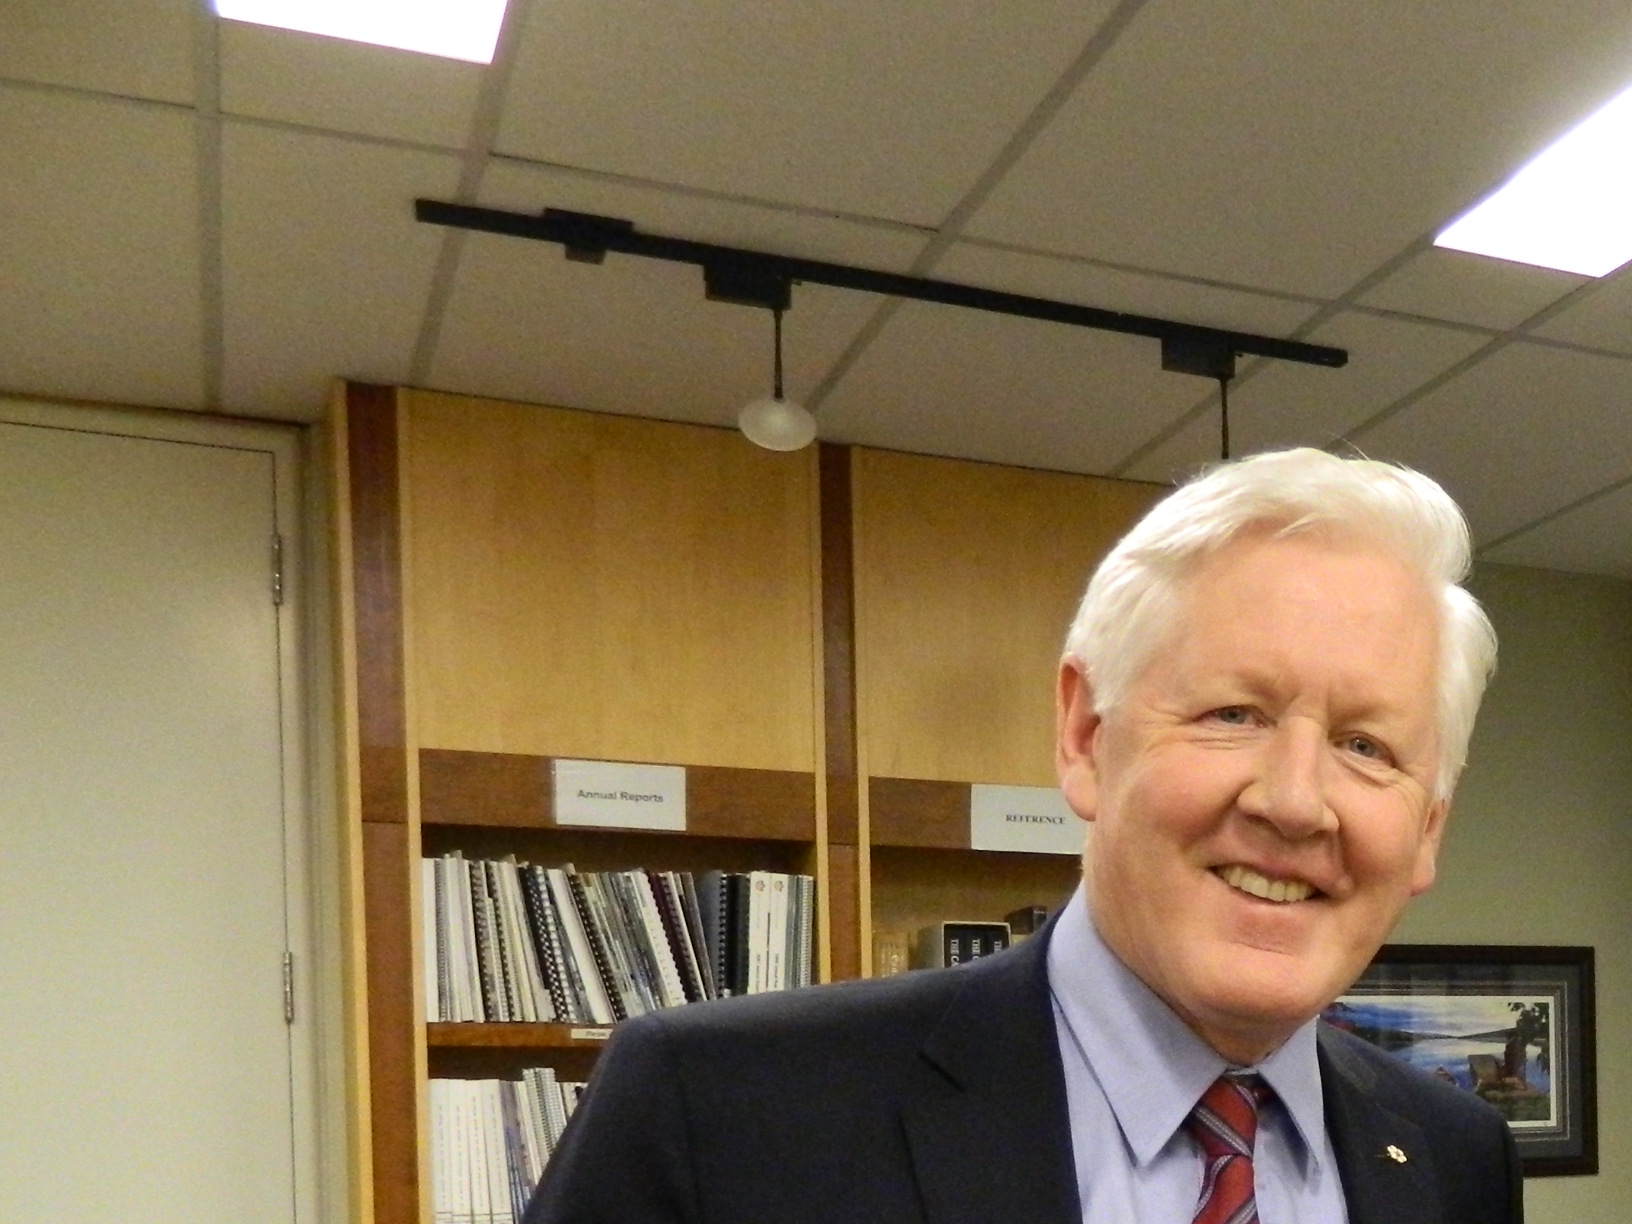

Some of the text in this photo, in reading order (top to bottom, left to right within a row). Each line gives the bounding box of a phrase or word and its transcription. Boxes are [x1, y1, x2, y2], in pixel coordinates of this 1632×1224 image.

[577, 789, 664, 803] Annual Reports
[1005, 814, 1066, 825] REFERENCE
